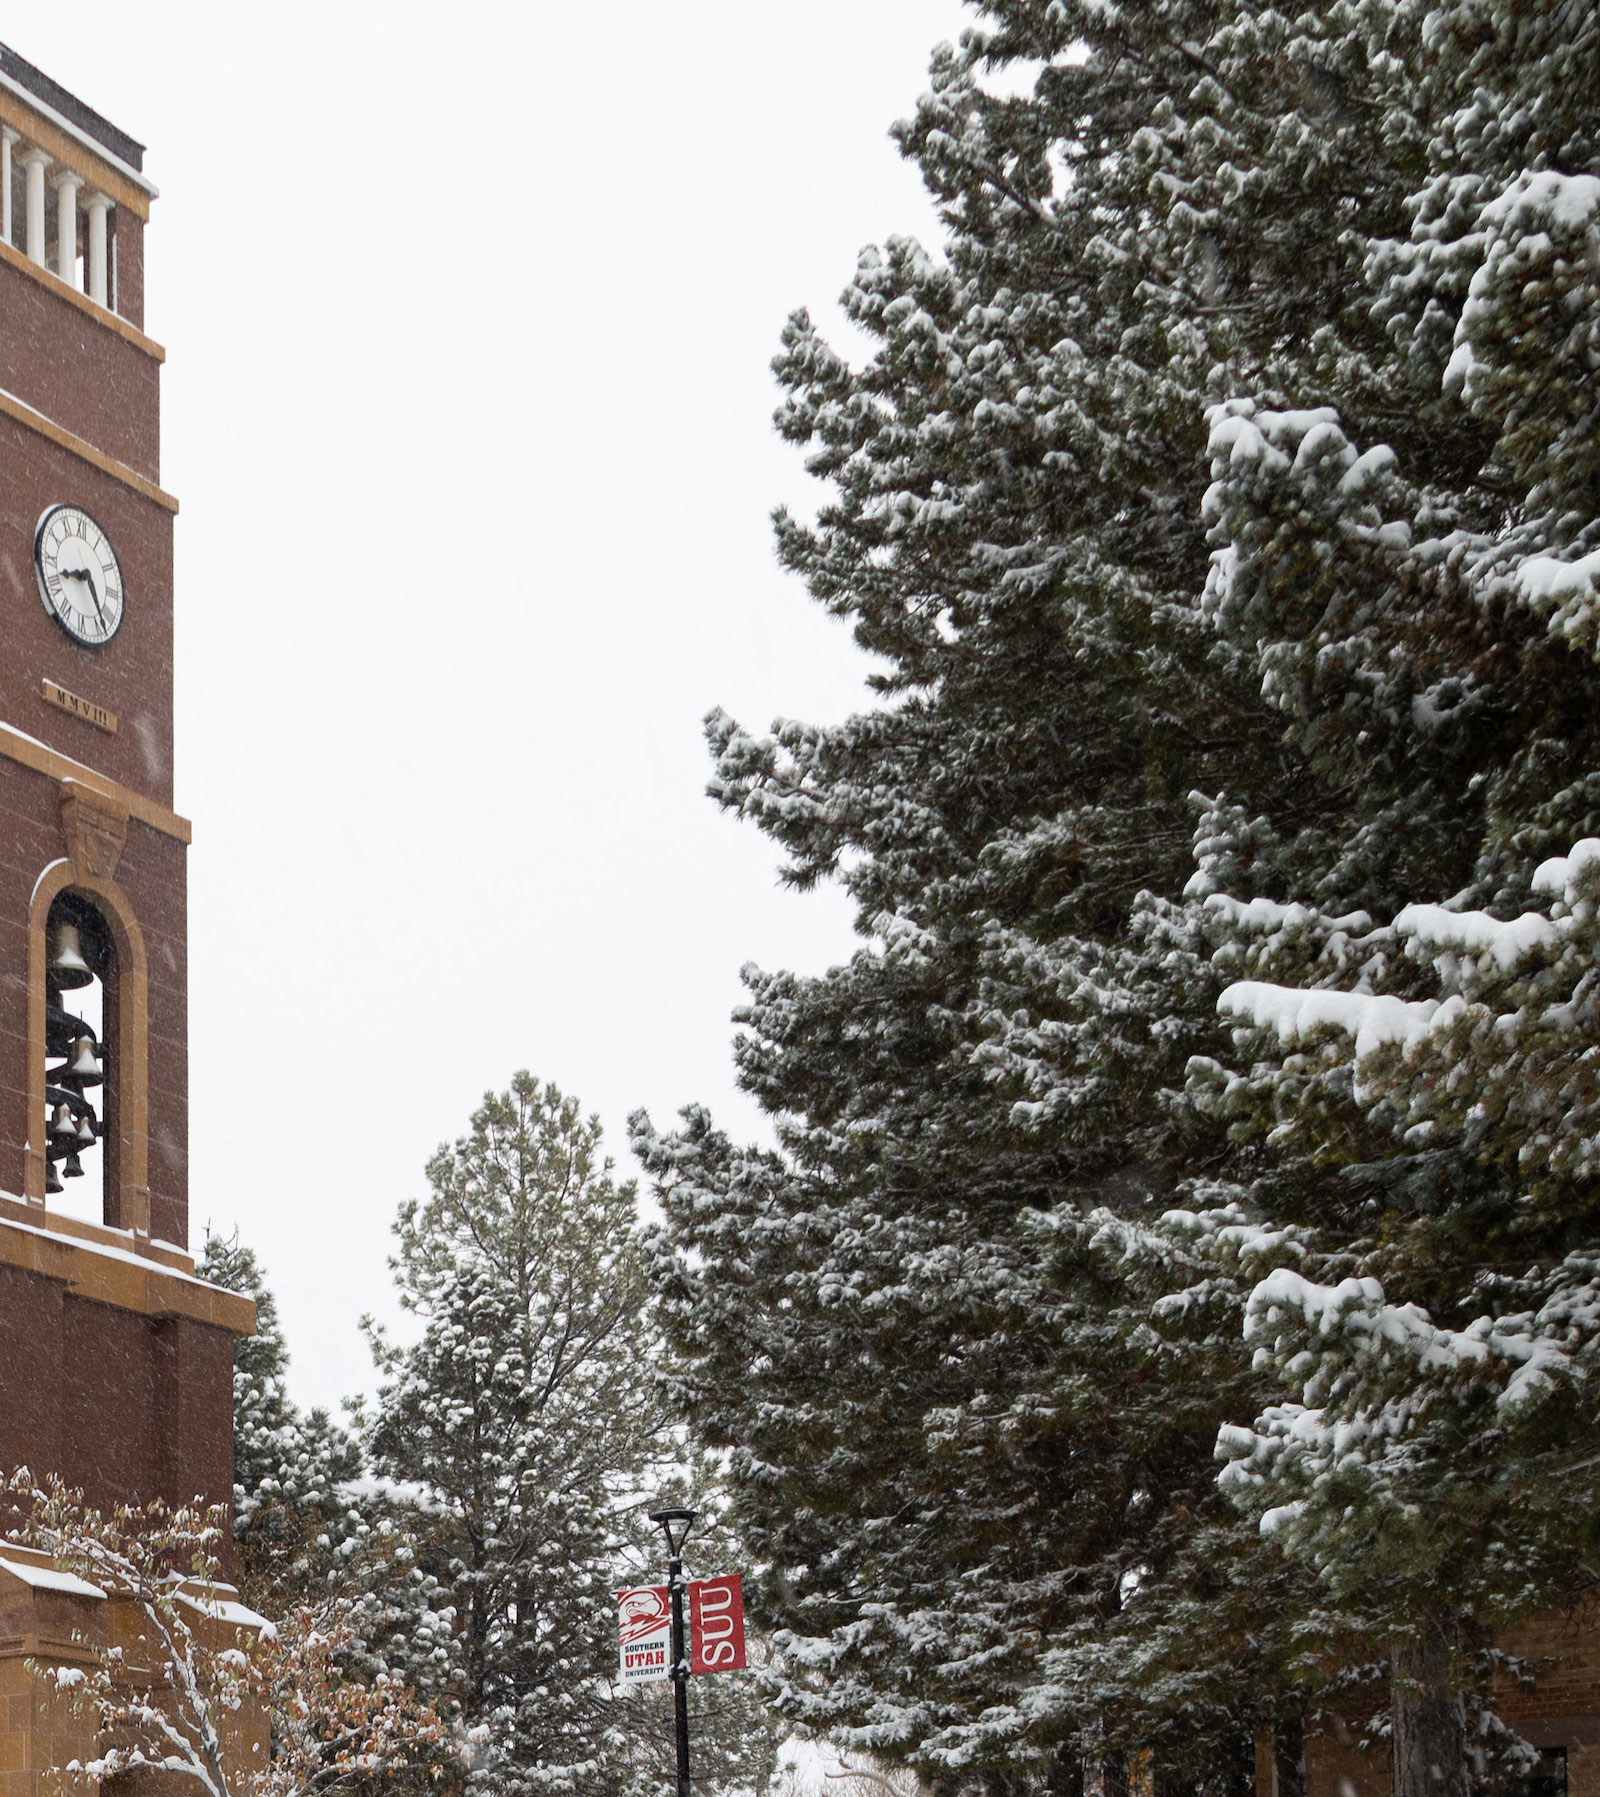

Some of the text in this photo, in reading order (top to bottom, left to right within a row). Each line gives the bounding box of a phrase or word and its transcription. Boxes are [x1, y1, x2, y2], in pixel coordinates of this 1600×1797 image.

[56, 689, 107, 726] MMVIII
[699, 1586, 735, 1666] SUU
[625, 1641, 665, 1653] SOUTHERN
[625, 1650, 665, 1668] UTAH
[625, 1667, 665, 1678] UNIVERSITY
